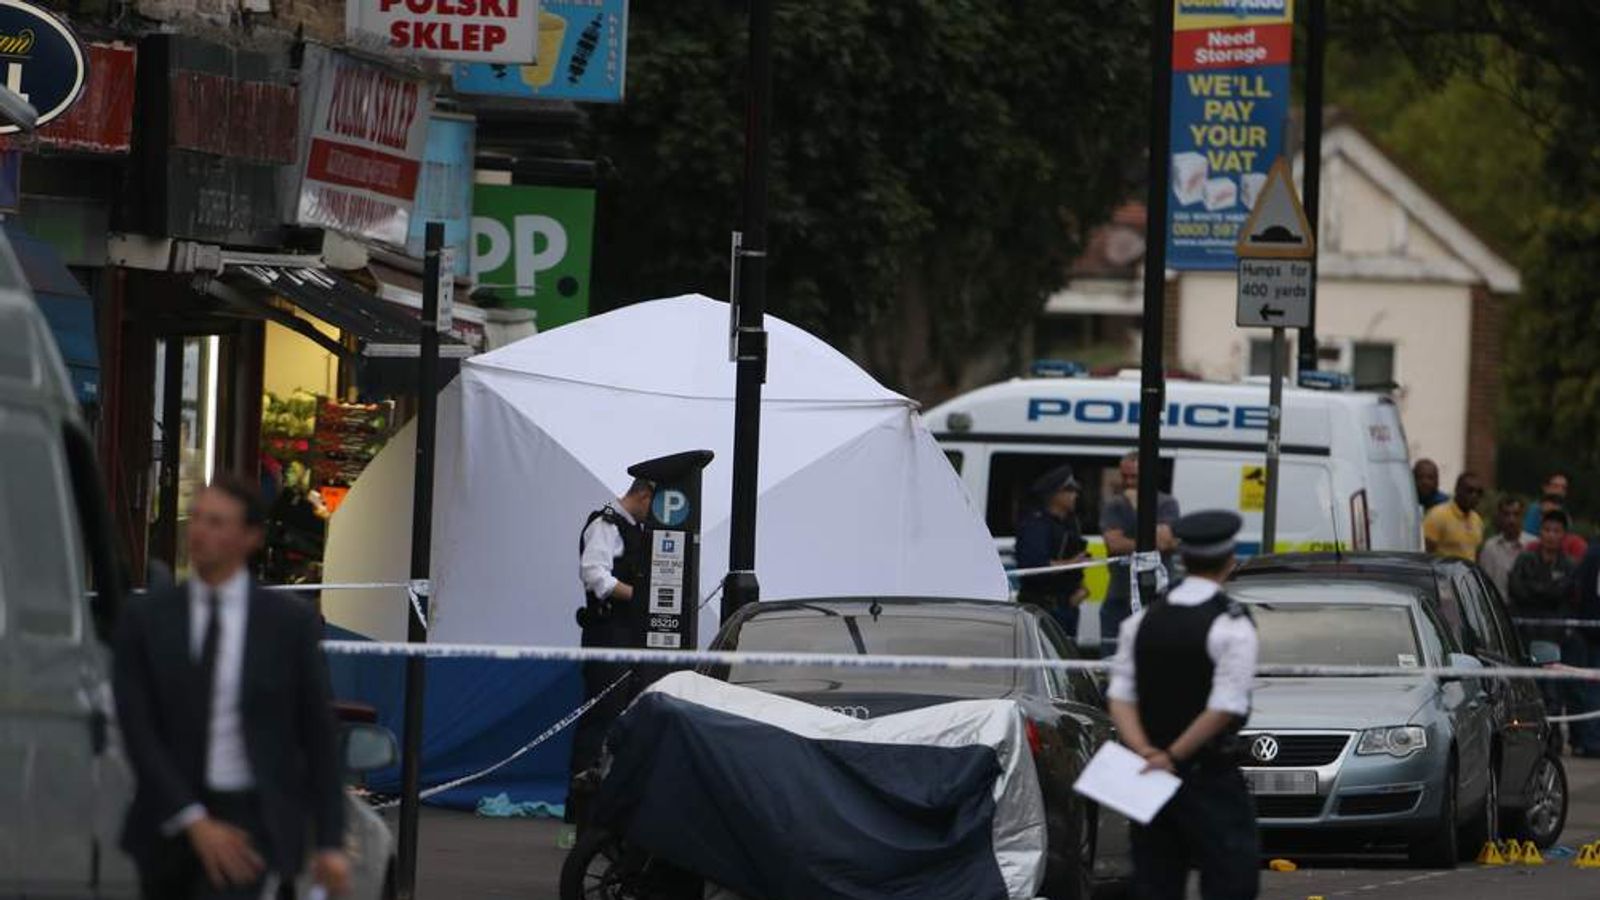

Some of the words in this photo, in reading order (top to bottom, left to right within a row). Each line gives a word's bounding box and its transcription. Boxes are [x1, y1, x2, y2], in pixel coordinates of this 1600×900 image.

[390, 20, 507, 51] SKLEP
[1208, 28, 1256, 46] Need
[1194, 46, 1268, 63] Storage
[1187, 74, 1272, 98] WE'LL
[1204, 99, 1255, 122] PAY
[1190, 125, 1267, 148] YOUR
[1207, 150, 1257, 172] VAT
[1242, 262, 1281, 277] Humps
[1290, 263, 1307, 276] for
[1241, 283, 1268, 297] 400
[1274, 285, 1307, 299] yards
[1027, 397, 1270, 430] POLICE
[663, 489, 686, 524] P
